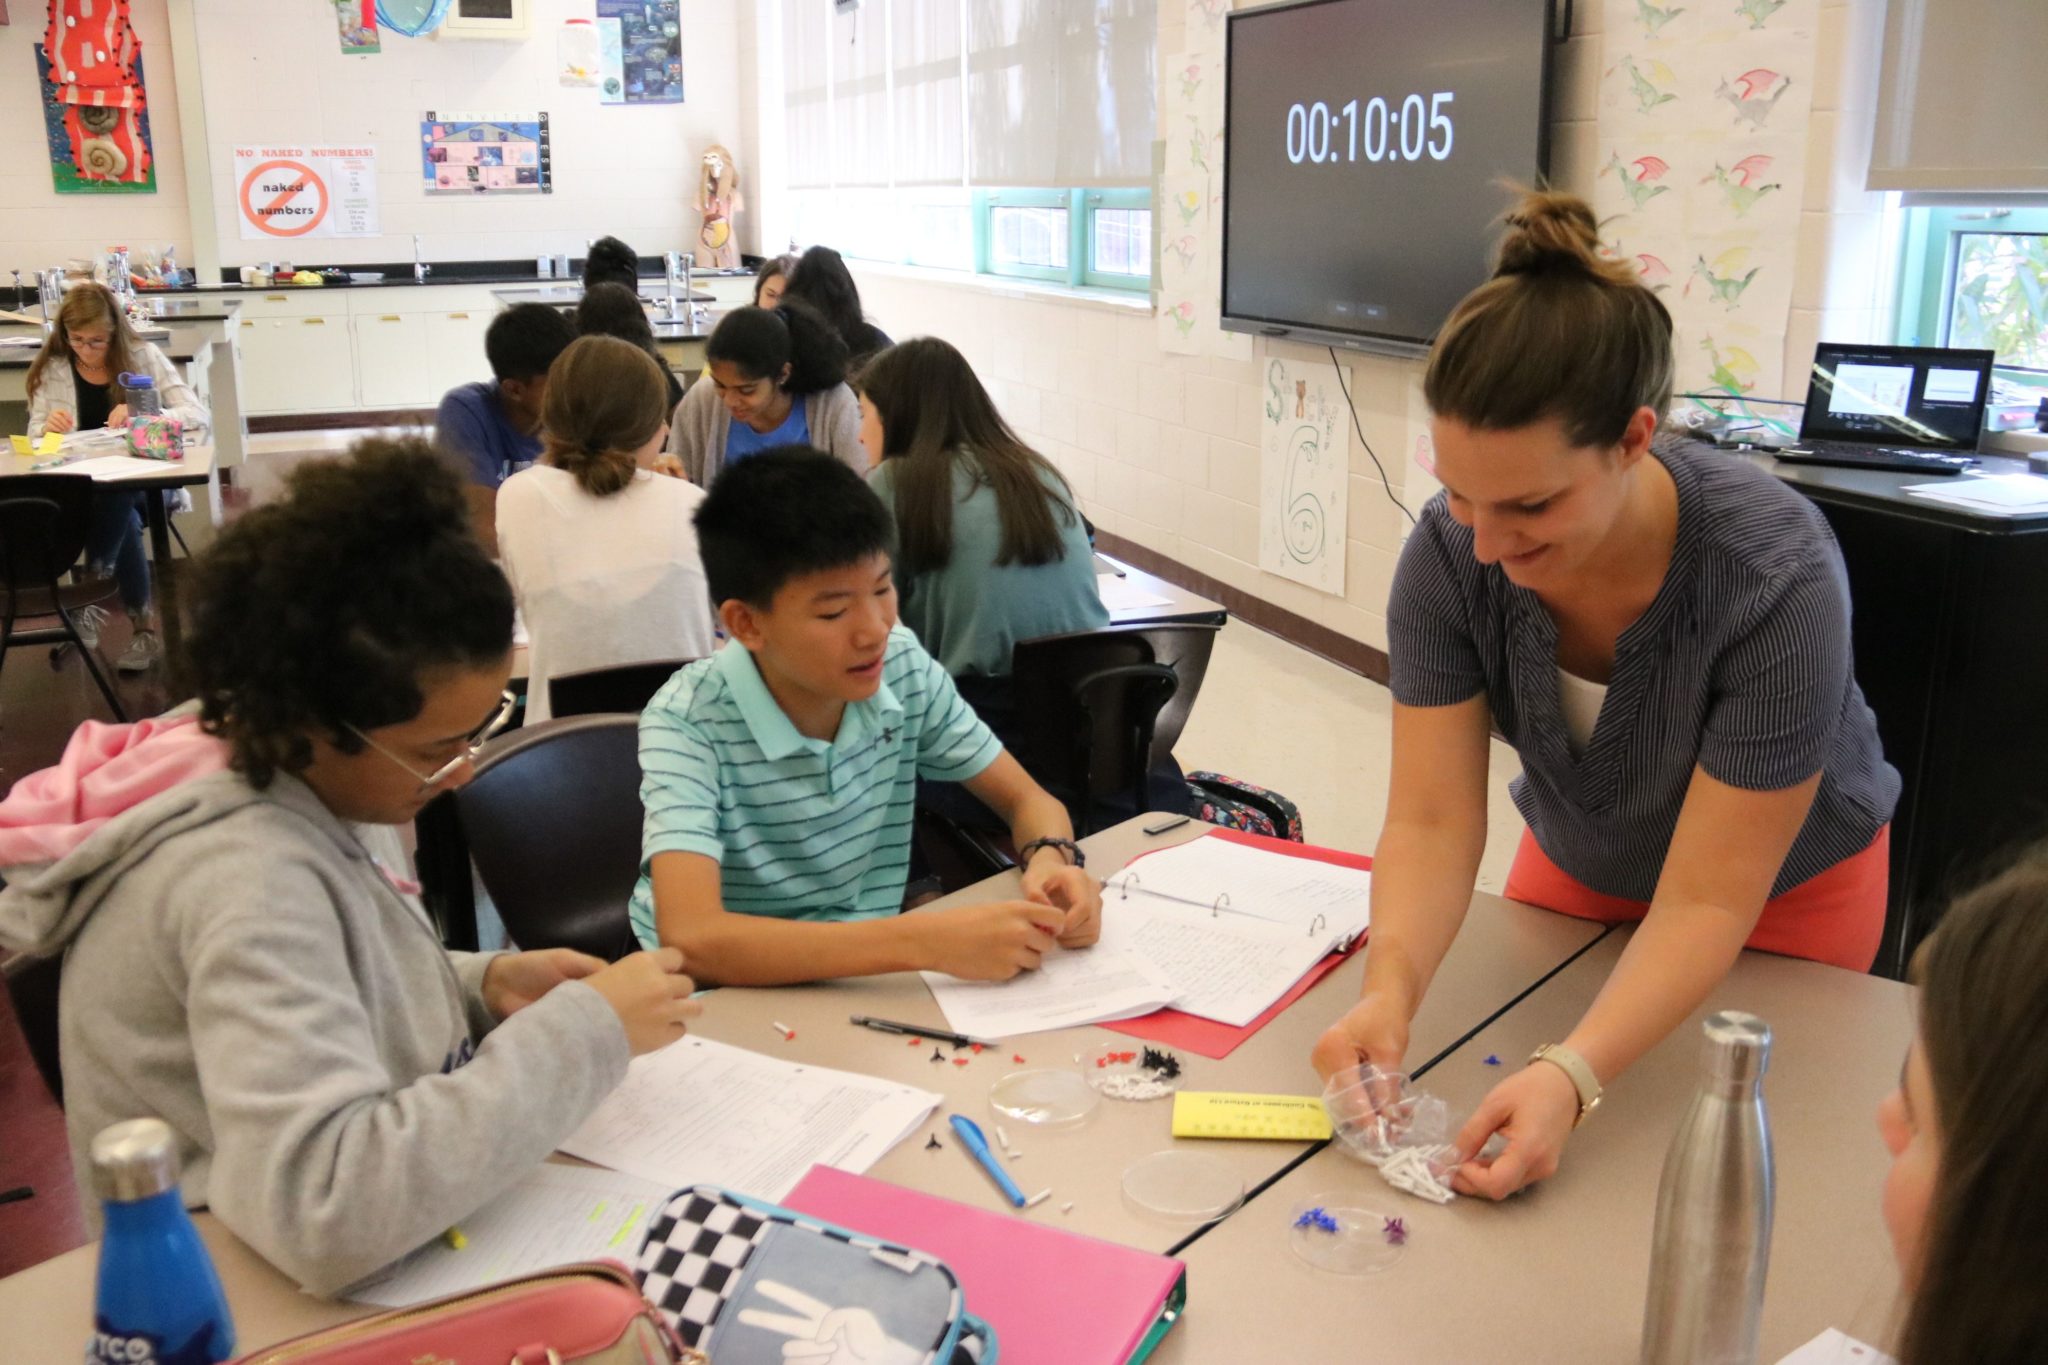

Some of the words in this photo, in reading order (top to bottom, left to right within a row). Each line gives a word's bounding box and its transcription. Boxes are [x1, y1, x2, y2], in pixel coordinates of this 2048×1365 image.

[427, 112, 534, 121] UNINVITED
[1286, 91, 1454, 163] 00:10:05
[236, 149, 254, 157] NO
[261, 149, 303, 157] NAKED
[311, 149, 373, 157] NUMBERS!
[539, 113, 551, 189] GUESTS
[263, 182, 304, 192] naked
[257, 206, 314, 215] numbers
